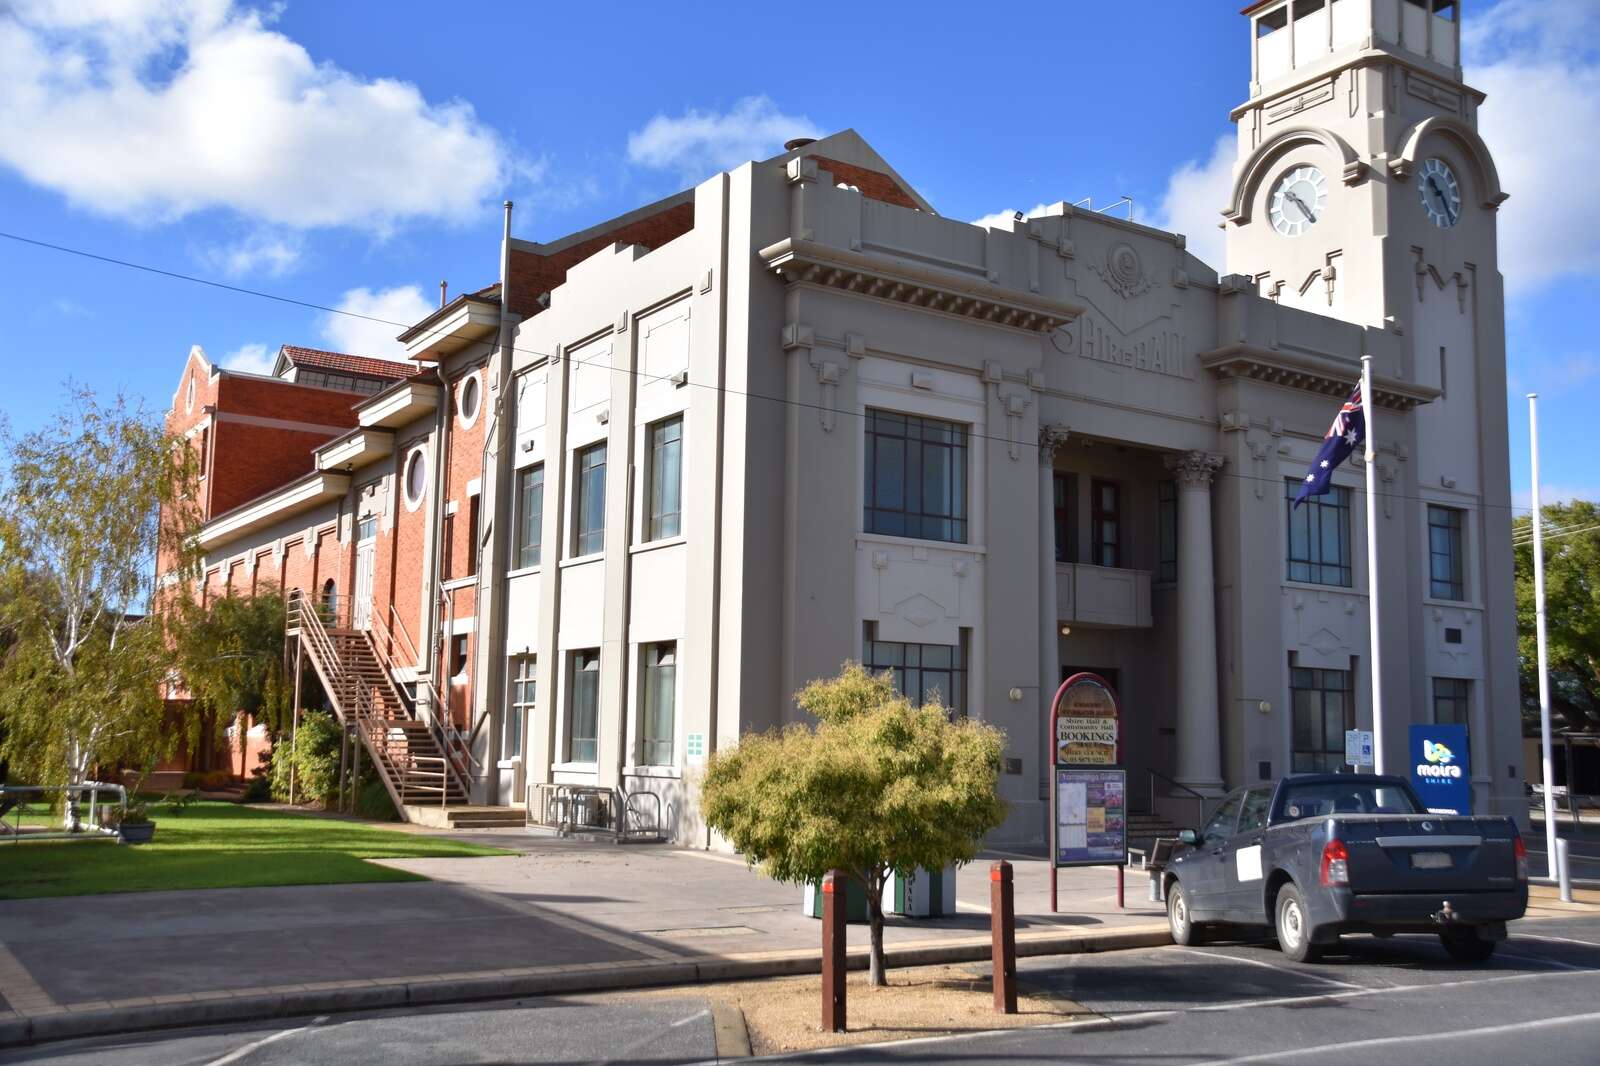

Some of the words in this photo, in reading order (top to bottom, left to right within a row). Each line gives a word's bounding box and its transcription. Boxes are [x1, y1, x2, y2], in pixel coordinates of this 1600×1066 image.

[1049, 315, 1132, 366] SHIRE
[1134, 331, 1184, 376] HALL
[1060, 732, 1114, 741] BOOKINGS
[1417, 763, 1462, 777] moira
